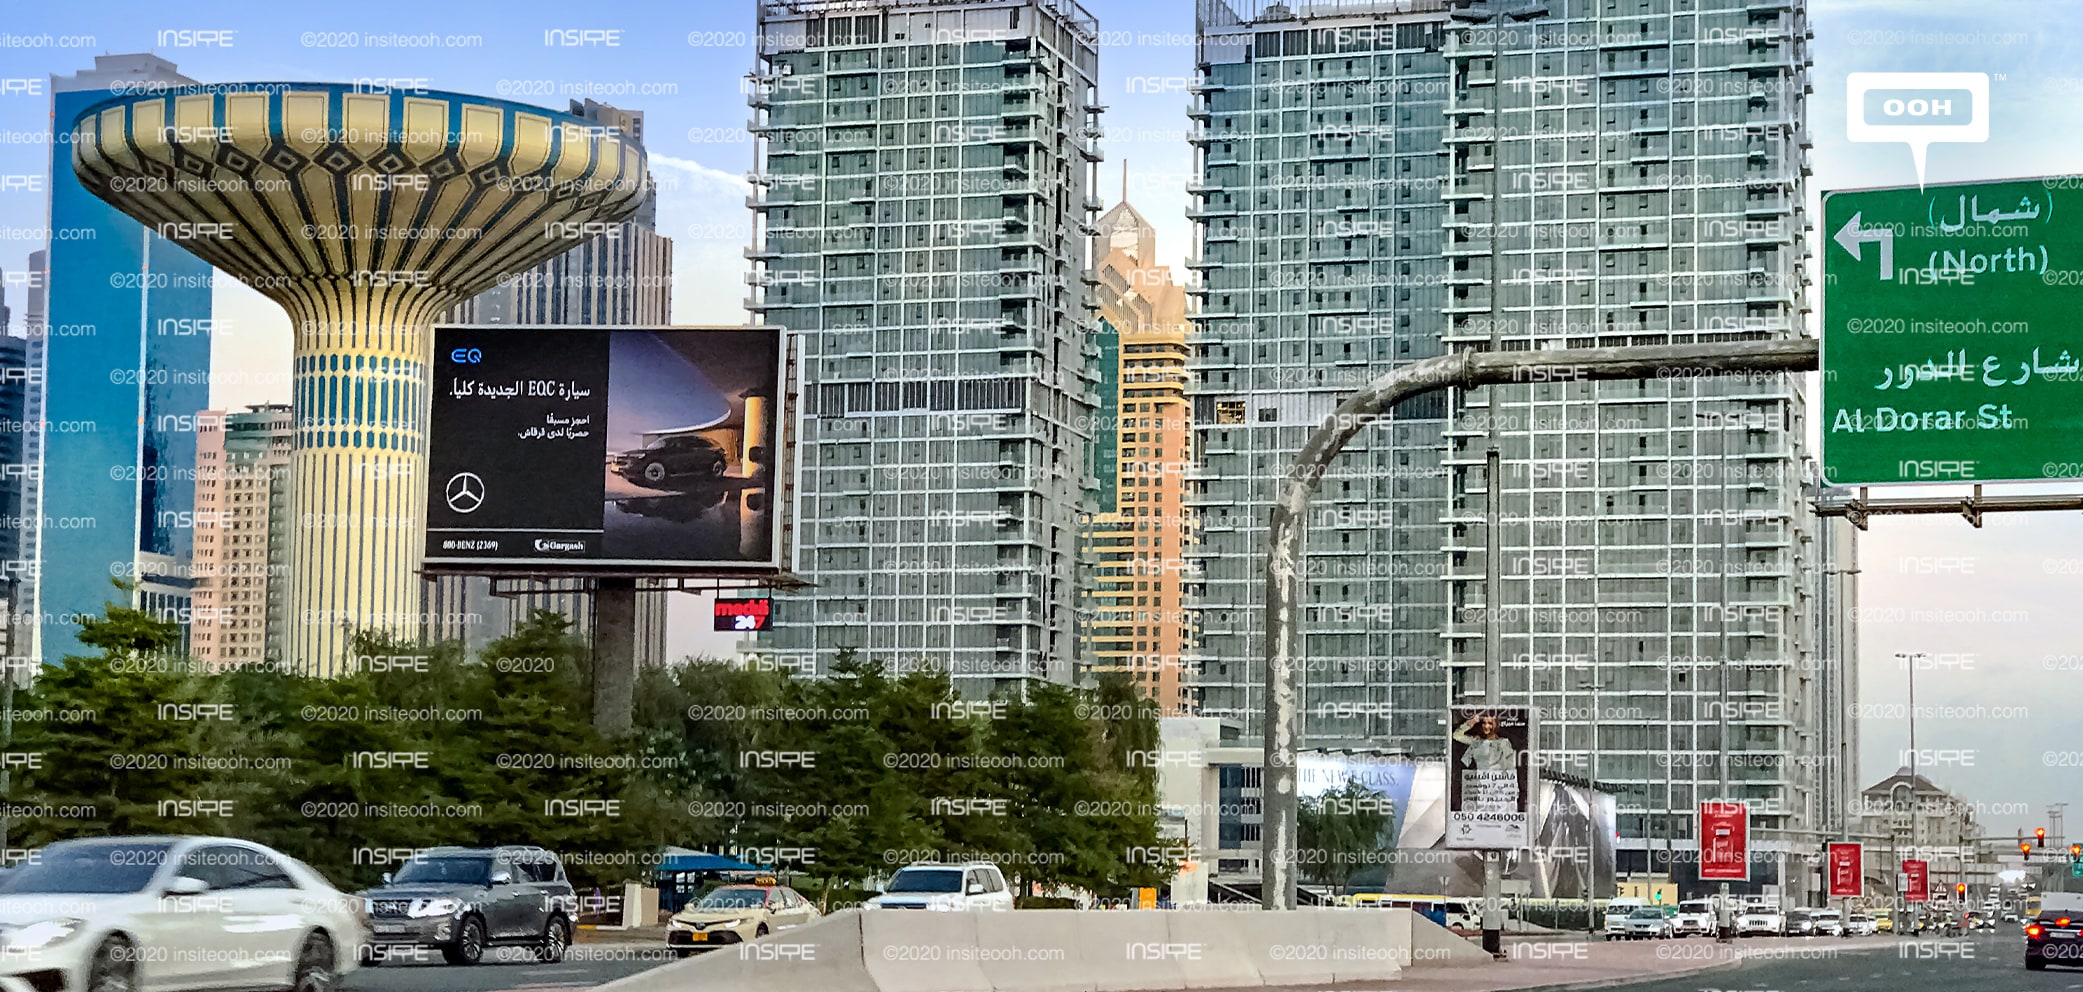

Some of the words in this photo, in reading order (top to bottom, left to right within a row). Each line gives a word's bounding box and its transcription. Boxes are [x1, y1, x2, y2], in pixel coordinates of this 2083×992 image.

[1929, 245, 2049, 281] (North)
[451, 348, 482, 364] EQ
[1982, 346, 2080, 388] شارع
[478, 380, 524, 400] الجديدة
[527, 380, 556, 396] EQC
[559, 381, 591, 401] سيارة
[1832, 408, 1865, 434] Al
[1877, 406, 1965, 433] Dorar
[1978, 403, 2013, 429] St
[550, 540, 584, 551] Gargash
[1453, 813, 1474, 821] 050
